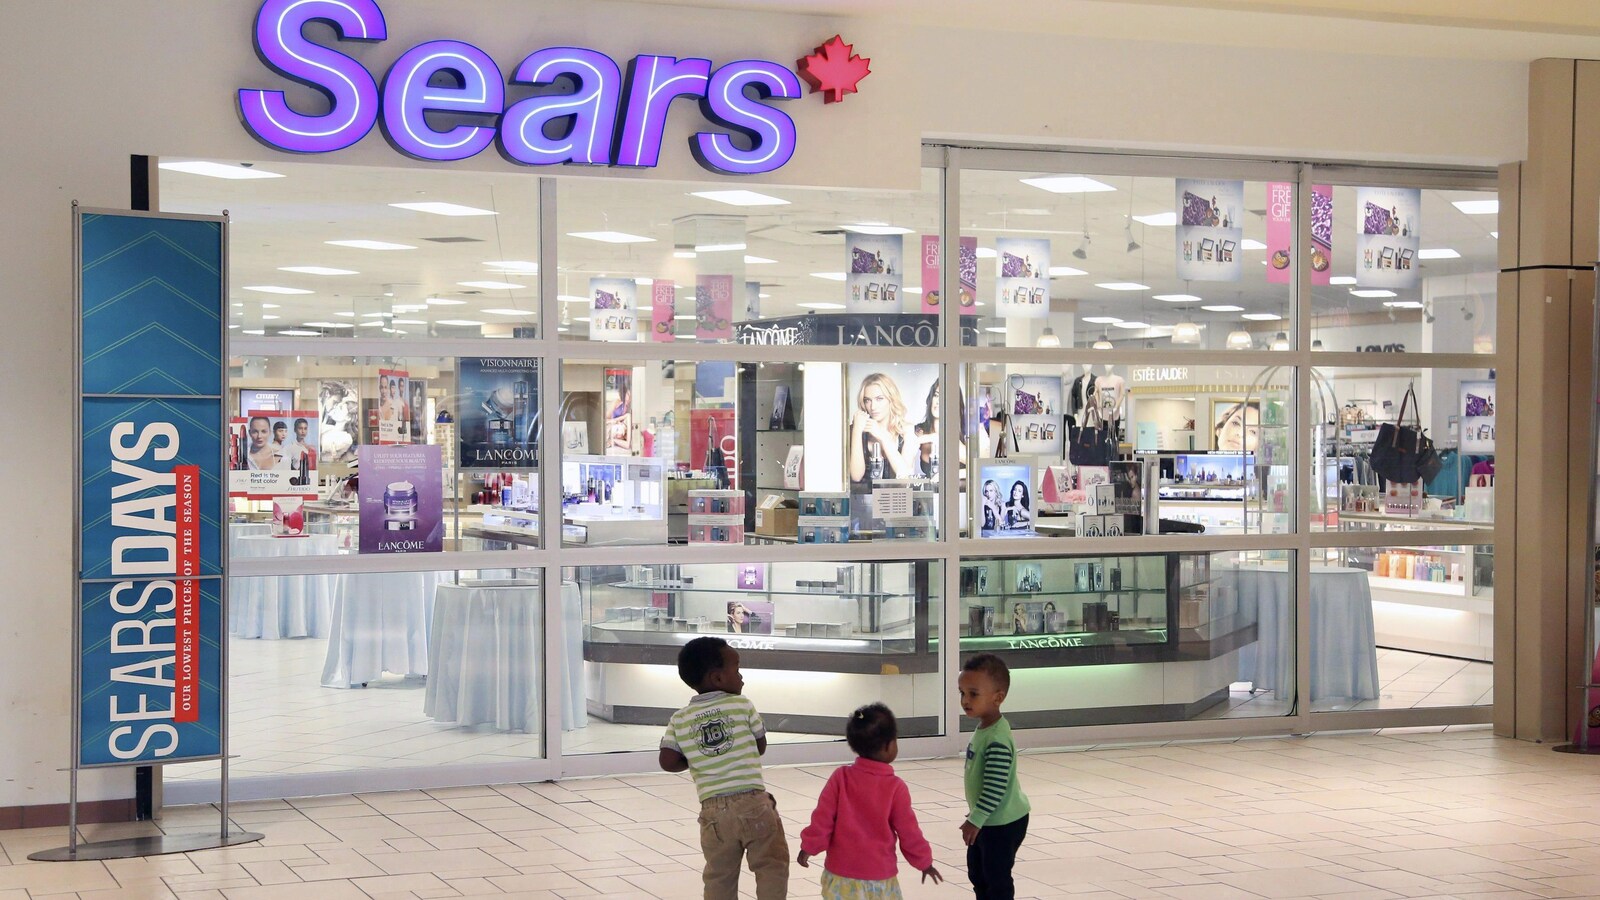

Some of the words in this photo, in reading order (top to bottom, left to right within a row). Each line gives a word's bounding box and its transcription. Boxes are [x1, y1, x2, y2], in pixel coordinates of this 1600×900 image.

[238, 0, 803, 174] Sears
[1272, 190, 1291, 204] FRE
[1272, 203, 1291, 217] GIF
[837, 320, 971, 347] LANCÔE
[1156, 367, 1188, 380] LAUDER
[476, 447, 538, 460] LANCÔM
[184, 475, 193, 523] SEASON
[184, 529, 193, 555] THE
[378, 540, 425, 551] LANCÔME
[183, 559, 193, 576] OF
[183, 579, 193, 625] PRICES
[182, 629, 192, 681] LOWEST
[182, 685, 192, 711] OUR
[694, 707, 722, 721] JUNIOR
